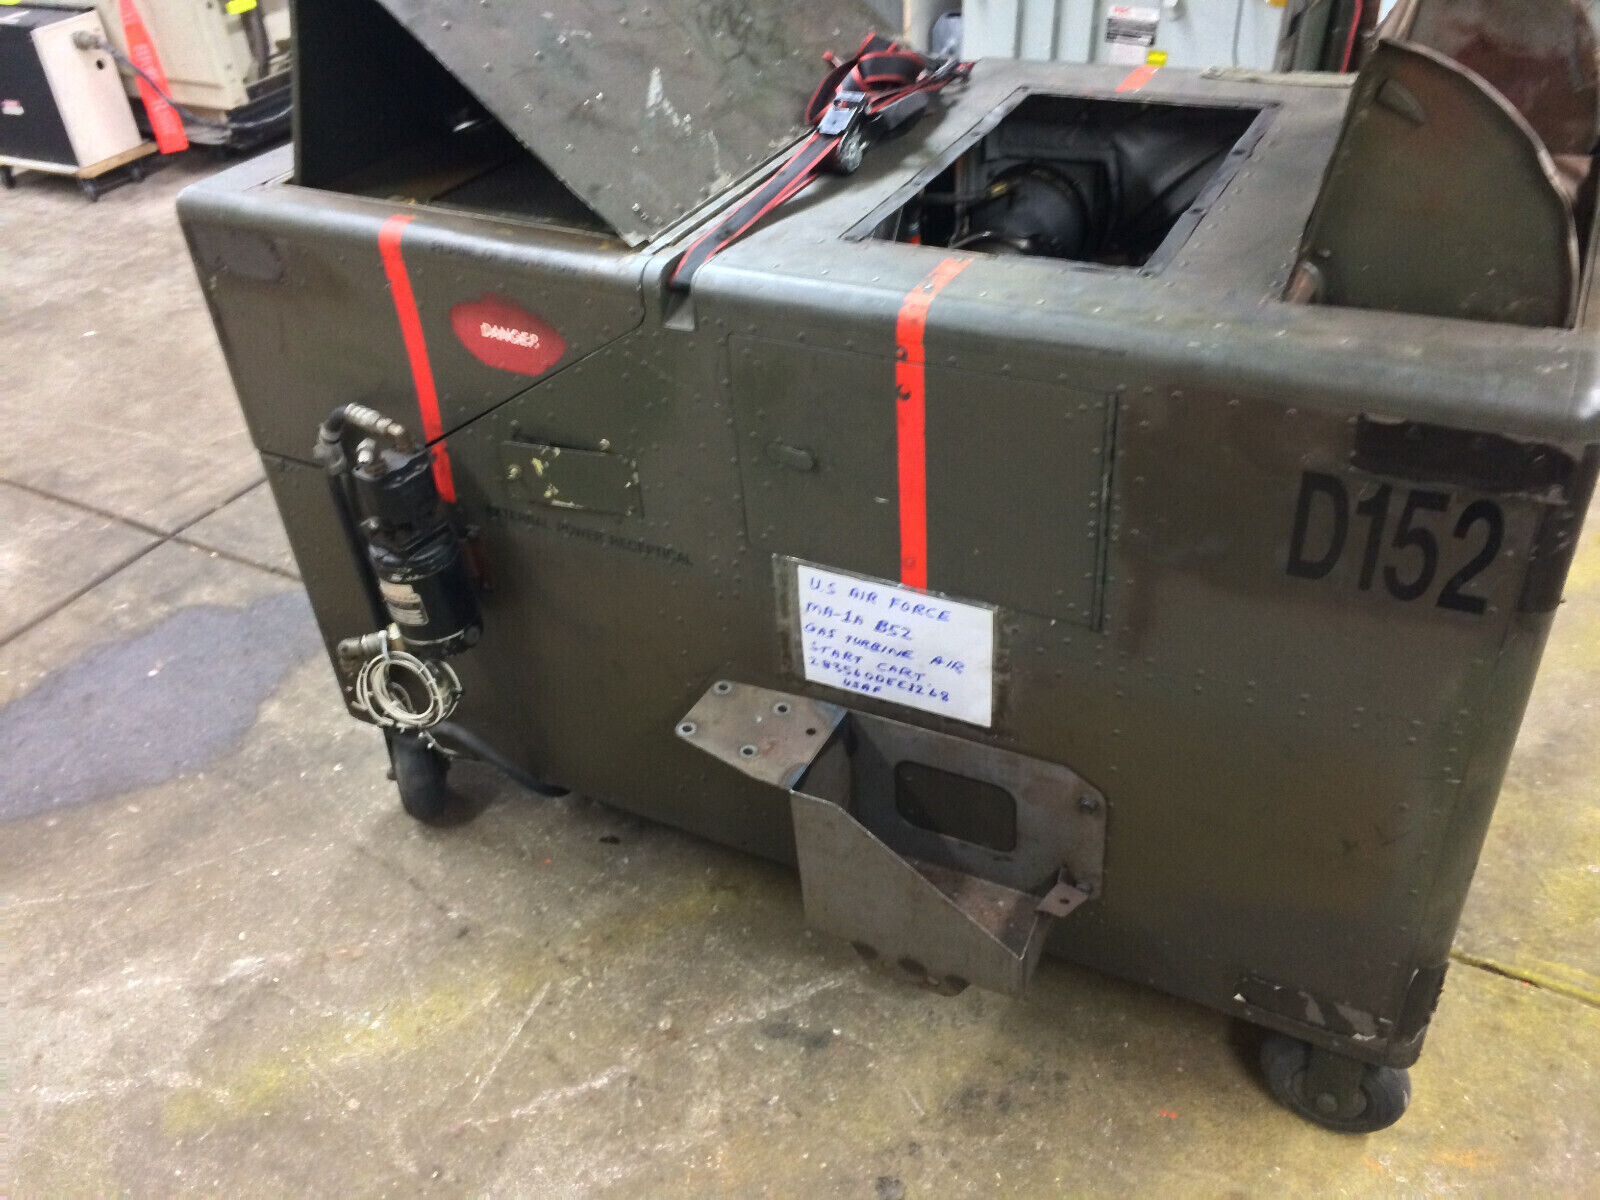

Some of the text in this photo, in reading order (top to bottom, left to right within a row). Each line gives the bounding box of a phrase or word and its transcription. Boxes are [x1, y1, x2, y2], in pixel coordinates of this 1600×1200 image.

[480, 322, 540, 350] DANGER
[1286, 470, 1504, 615] D152
[849, 586, 878, 604] AIR
[889, 597, 952, 622] FORCE
[873, 619, 912, 641] B52
[809, 640, 864, 664] START
[845, 635, 914, 659] TURBINE
[929, 655, 966, 675] AIR
[842, 678, 882, 694] USAF
